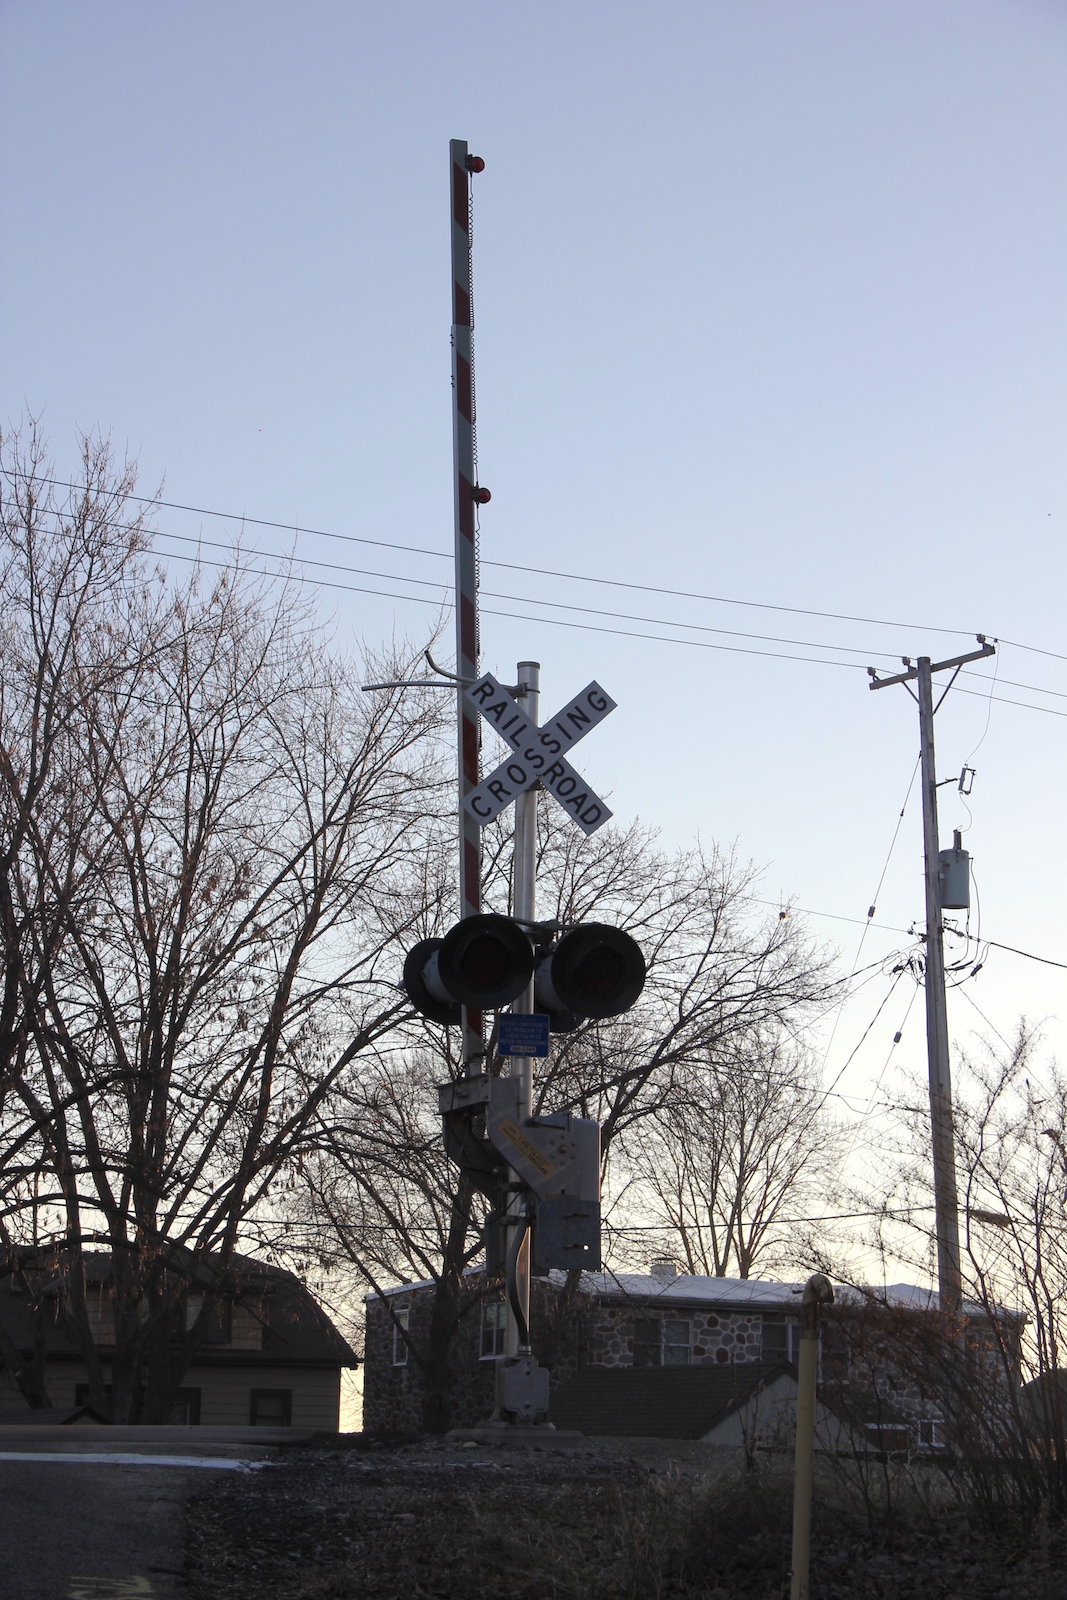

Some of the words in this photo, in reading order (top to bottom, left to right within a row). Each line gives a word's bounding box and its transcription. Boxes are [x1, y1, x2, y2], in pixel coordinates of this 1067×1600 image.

[471, 680, 528, 748] RAIL
[542, 761, 602, 825] ROAD
[471, 690, 608, 818] CROSSING
